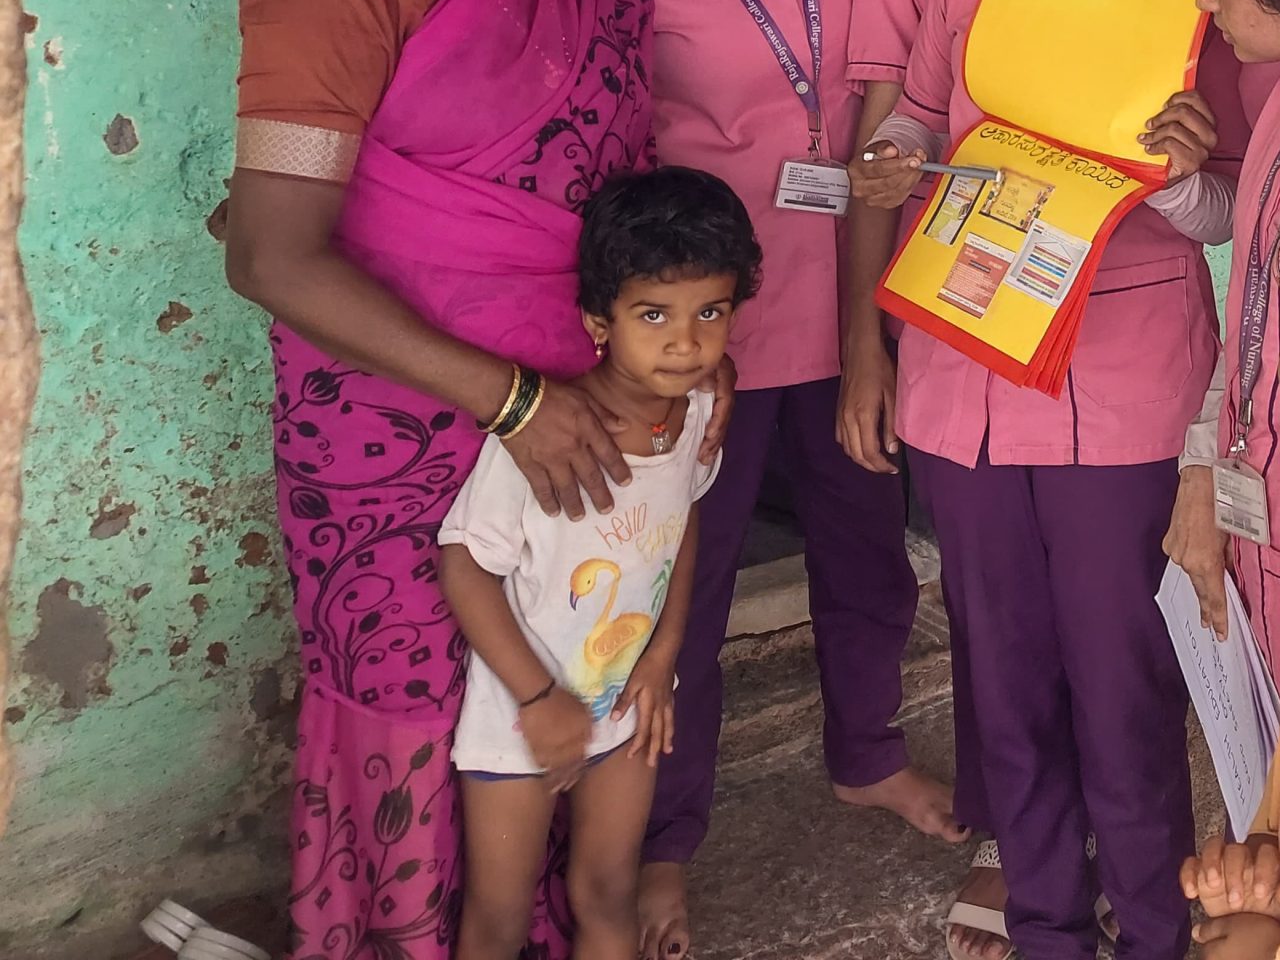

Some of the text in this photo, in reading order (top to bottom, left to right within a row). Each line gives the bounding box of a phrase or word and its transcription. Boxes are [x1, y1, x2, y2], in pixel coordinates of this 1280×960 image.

[760, 21, 799, 82] RajaRajeswari
[810, 13, 822, 47] College
[1252, 281, 1268, 324] College
[1241, 338, 1262, 388] Nursing
[595, 502, 647, 550] hello
[1185, 619, 1220, 721] EDUCATION
[1222, 733, 1245, 805] HEALTH
